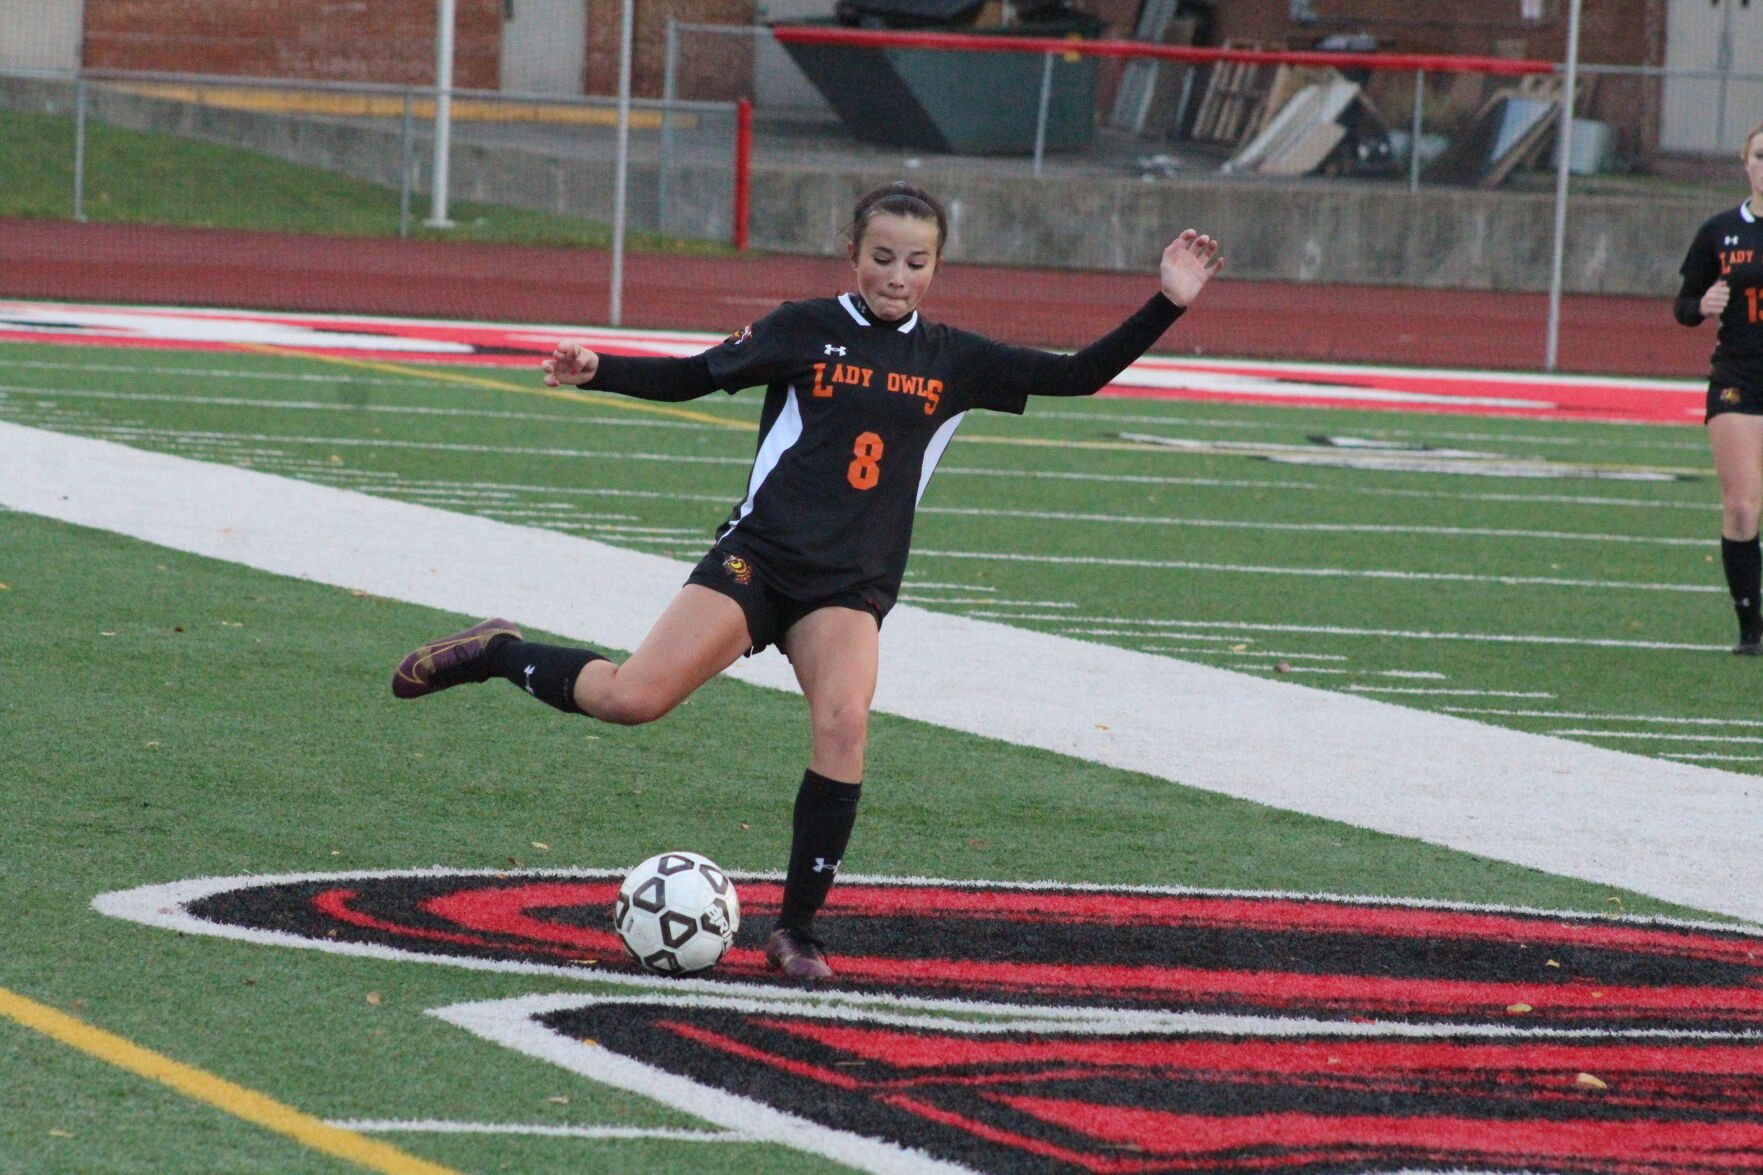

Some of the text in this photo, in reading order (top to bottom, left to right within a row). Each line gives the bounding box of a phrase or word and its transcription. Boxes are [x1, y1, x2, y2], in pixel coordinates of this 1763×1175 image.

[1719, 249, 1754, 274] LADY
[1744, 286, 1763, 323] 1
[813, 363, 944, 415] LADY OWLS
[847, 431, 884, 490] 8
